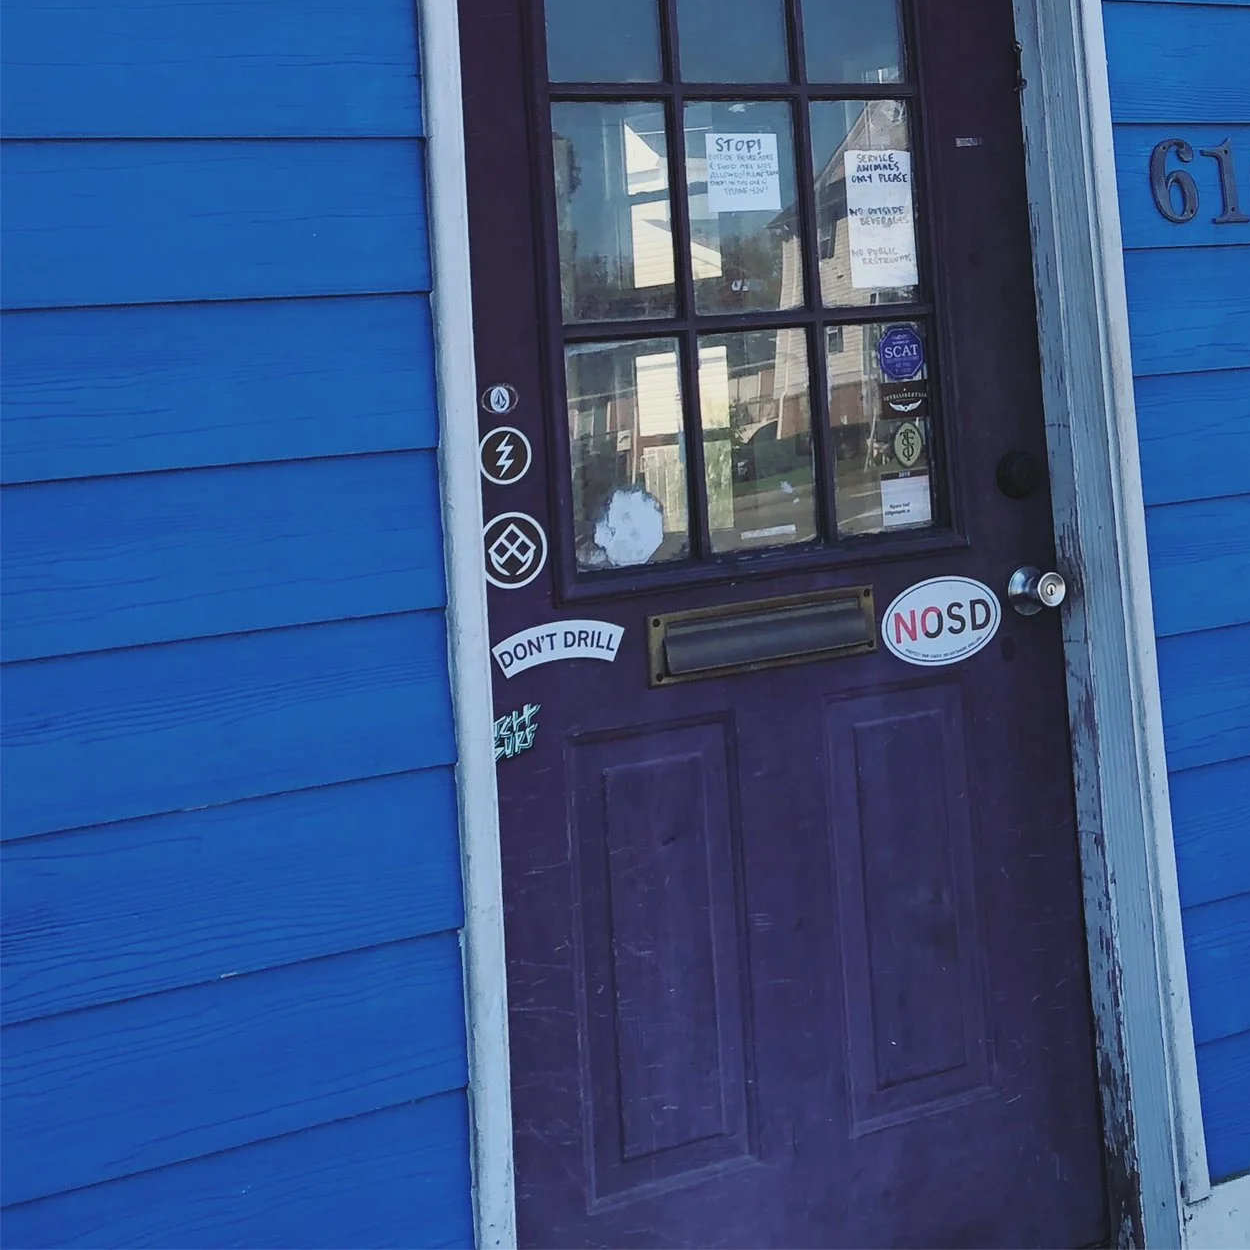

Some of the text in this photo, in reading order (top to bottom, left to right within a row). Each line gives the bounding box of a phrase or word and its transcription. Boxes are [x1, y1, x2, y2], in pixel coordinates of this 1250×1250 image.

[715, 137, 762, 156] STOP!
[856, 152, 895, 164] SERVICE
[856, 161, 900, 173] ANIMALS
[851, 173, 908, 183] ONLY PLEASE
[849, 205, 904, 217] NO OUTSIDE
[860, 216, 910, 228] BEVERAGES
[852, 246, 900, 257] NO PUBLIC
[861, 253, 913, 265] RESTROOMS
[884, 344, 919, 359] SCAT
[893, 598, 992, 645] NOSD
[498, 630, 616, 669] DON'T DRILL
[493, 703, 541, 743] TCH
